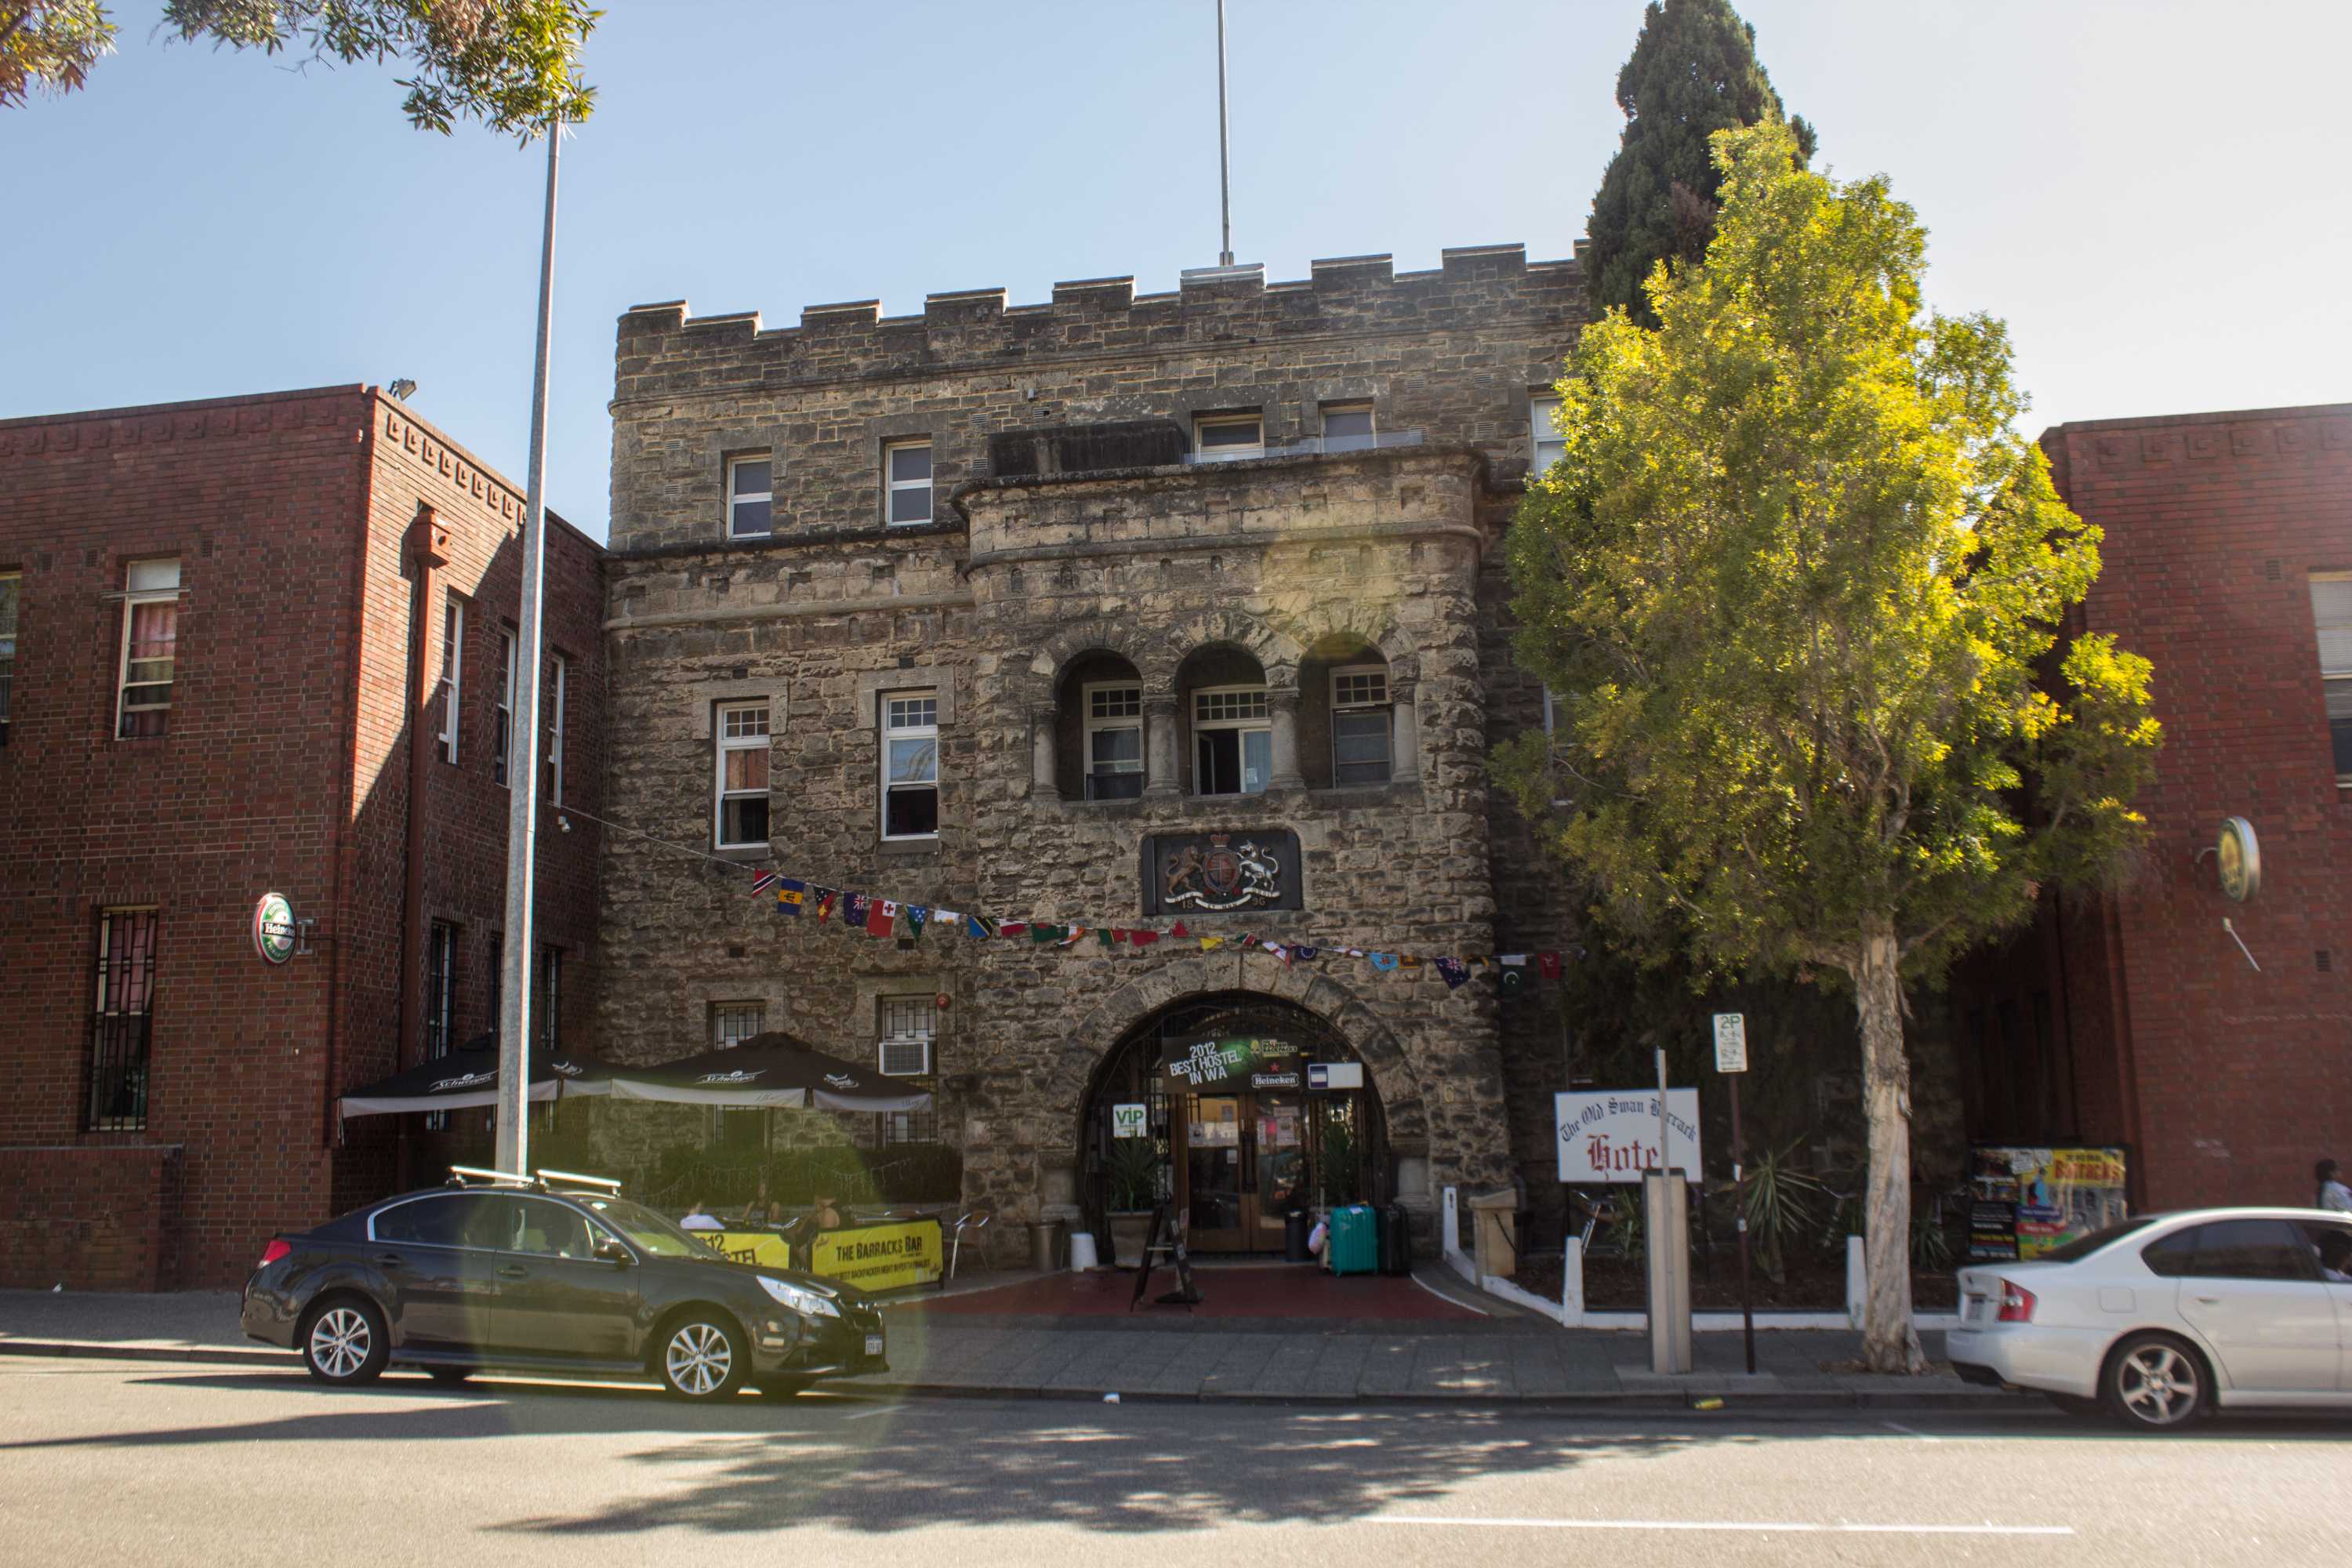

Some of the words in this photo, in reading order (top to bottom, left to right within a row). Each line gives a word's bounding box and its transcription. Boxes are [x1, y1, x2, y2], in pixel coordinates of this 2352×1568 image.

[1182, 900, 1193, 909] 18
[1720, 1016, 1741, 1029] 2P
[1189, 1041, 1217, 1058] 2012
[1169, 1058, 1199, 1076] BEST
[1199, 1051, 1242, 1070] HOSTEL
[1189, 1070, 1203, 1085] IN
[1204, 1066, 1228, 1082] WA
[1254, 1073, 1296, 1086] Heineken
[1559, 1119, 1581, 1142] The
[1581, 1102, 1605, 1124] Old
[1608, 1096, 1645, 1116] Swan
[1650, 1098, 1697, 1142] Brrack
[837, 1245, 854, 1261] THE
[855, 1238, 903, 1260] BARRACKS
[905, 1235, 923, 1252] BAR
